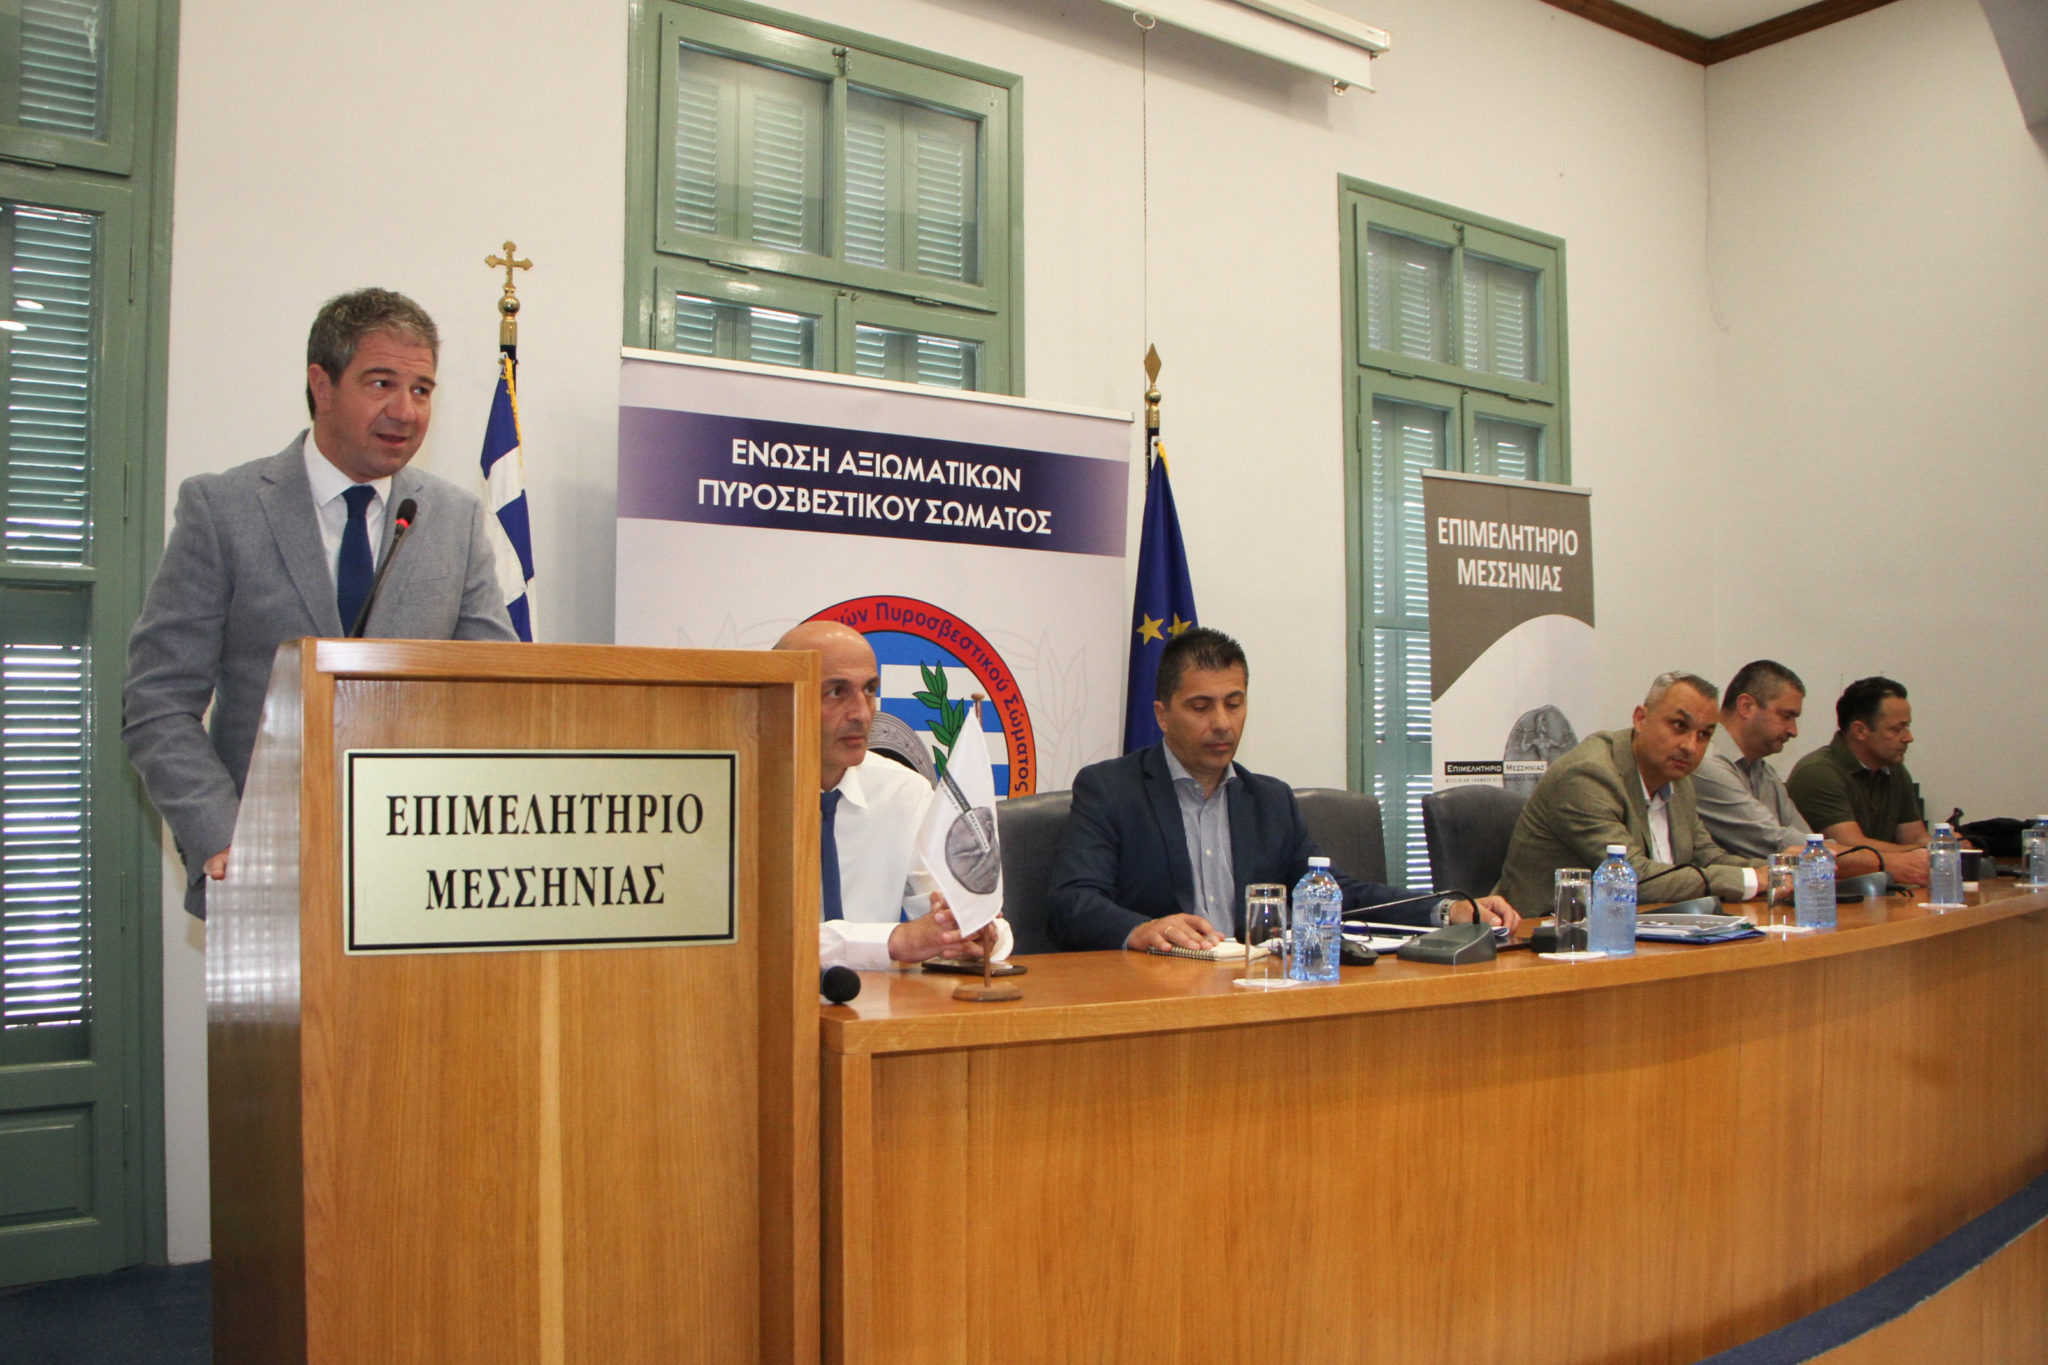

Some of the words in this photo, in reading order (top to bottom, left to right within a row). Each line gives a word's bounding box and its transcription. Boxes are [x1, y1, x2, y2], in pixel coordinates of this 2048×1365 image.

[731, 438, 830, 472] ΕΝΩΣΗ
[837, 450, 1021, 492] ΑΞΙΩΜΑΤΙΚΩΝ
[699, 478, 921, 523] ΠΥΡΟΣΒΕΣΤΙΚΟΥ
[924, 499, 1052, 535] ΣΩΜΑΤΟΣ
[1438, 516, 1579, 556] ΕΠΙΜΕΛΗΤΗΡΙΟ
[1457, 558, 1563, 592] ΜΕΣΣΗΝΙΑΣ
[876, 602, 1009, 692] Πυροσβεστικού
[1003, 693, 1029, 792] Σώματος
[386, 792, 704, 836] ΕΠΙΜΕΛΗΤΗΡΙΟ
[425, 863, 665, 910] ΜΕΣΣΗΝΙΑΣ
